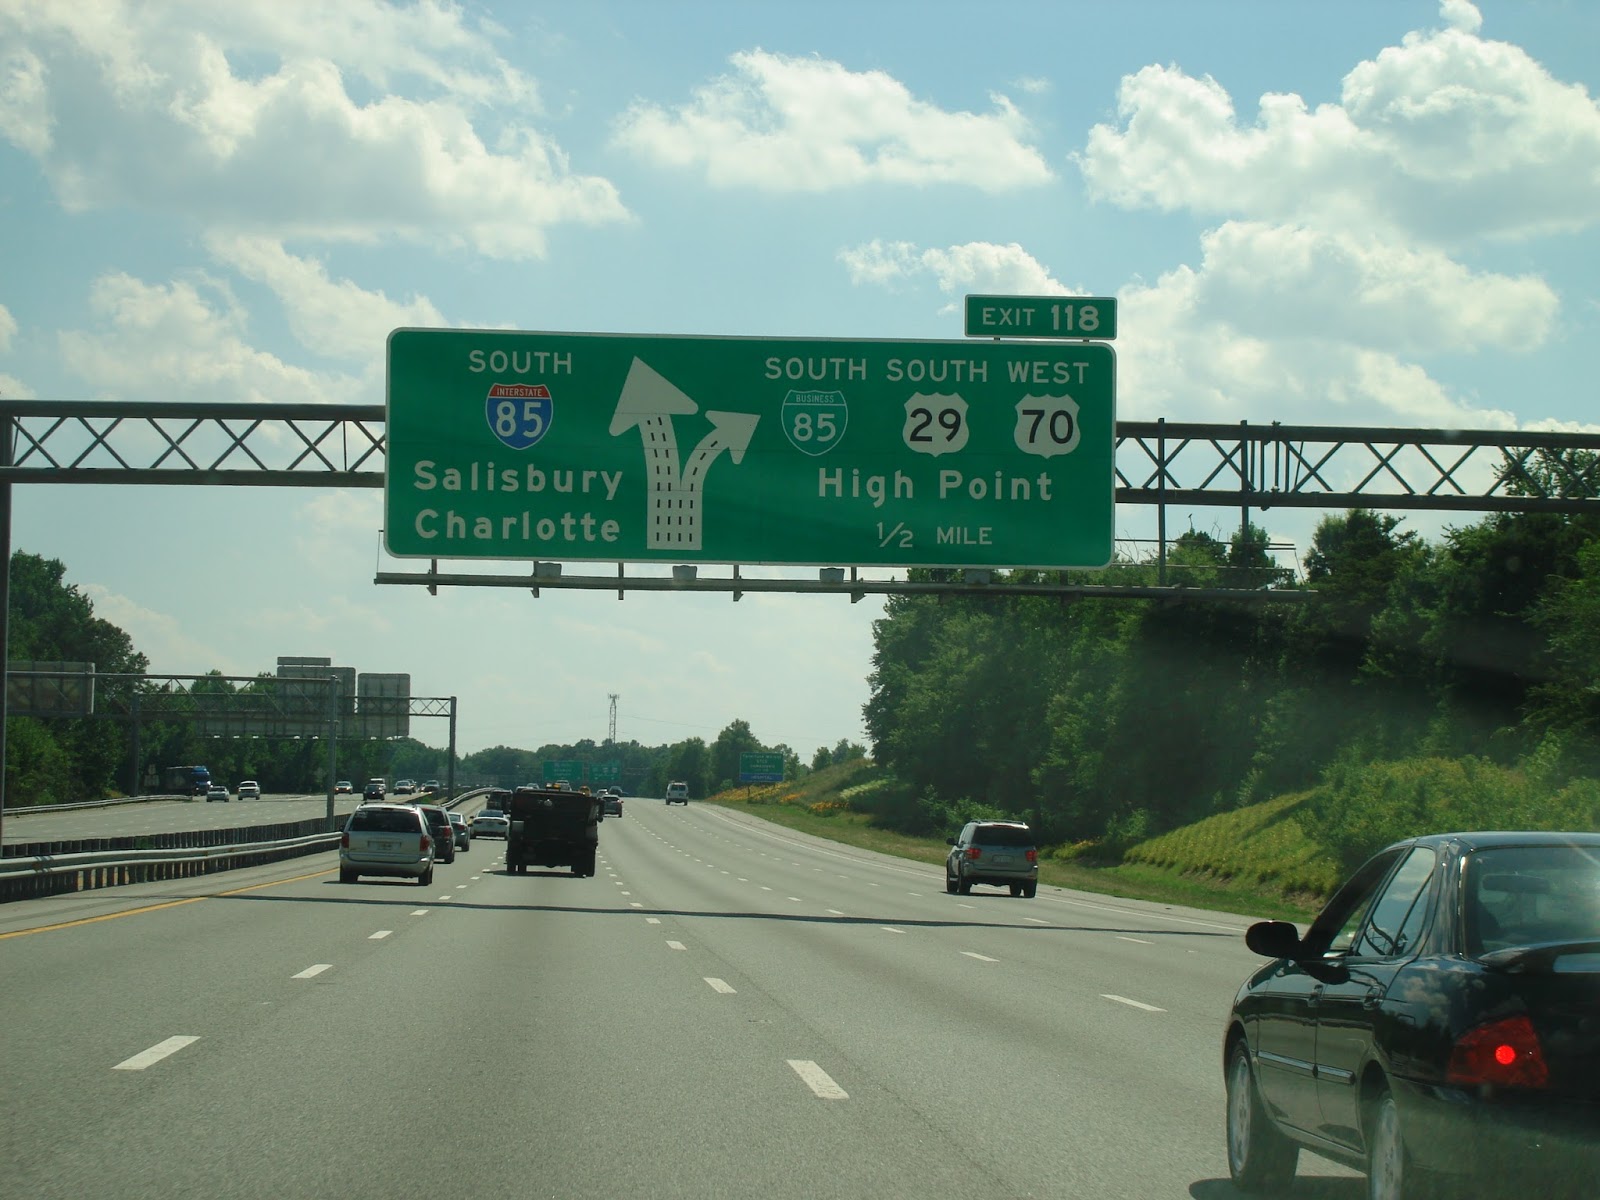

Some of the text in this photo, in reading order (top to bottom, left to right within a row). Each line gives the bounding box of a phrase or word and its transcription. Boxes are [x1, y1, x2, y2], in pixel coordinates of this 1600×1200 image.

[982, 304, 1099, 331] EXIT 118
[469, 350, 572, 375] SOUTH
[764, 356, 1089, 384] SOUTH SOUTH WEST
[496, 387, 543, 397] INTERSTATE
[795, 394, 834, 404] BUSINESS
[496, 401, 543, 438] 85
[793, 413, 836, 442] 85
[909, 407, 961, 443] 29
[1022, 409, 1074, 445] 70
[413, 461, 623, 501] Salisbury
[818, 467, 1053, 508] High Point
[414, 509, 620, 543] Charlotte
[937, 526, 993, 545] MILE
